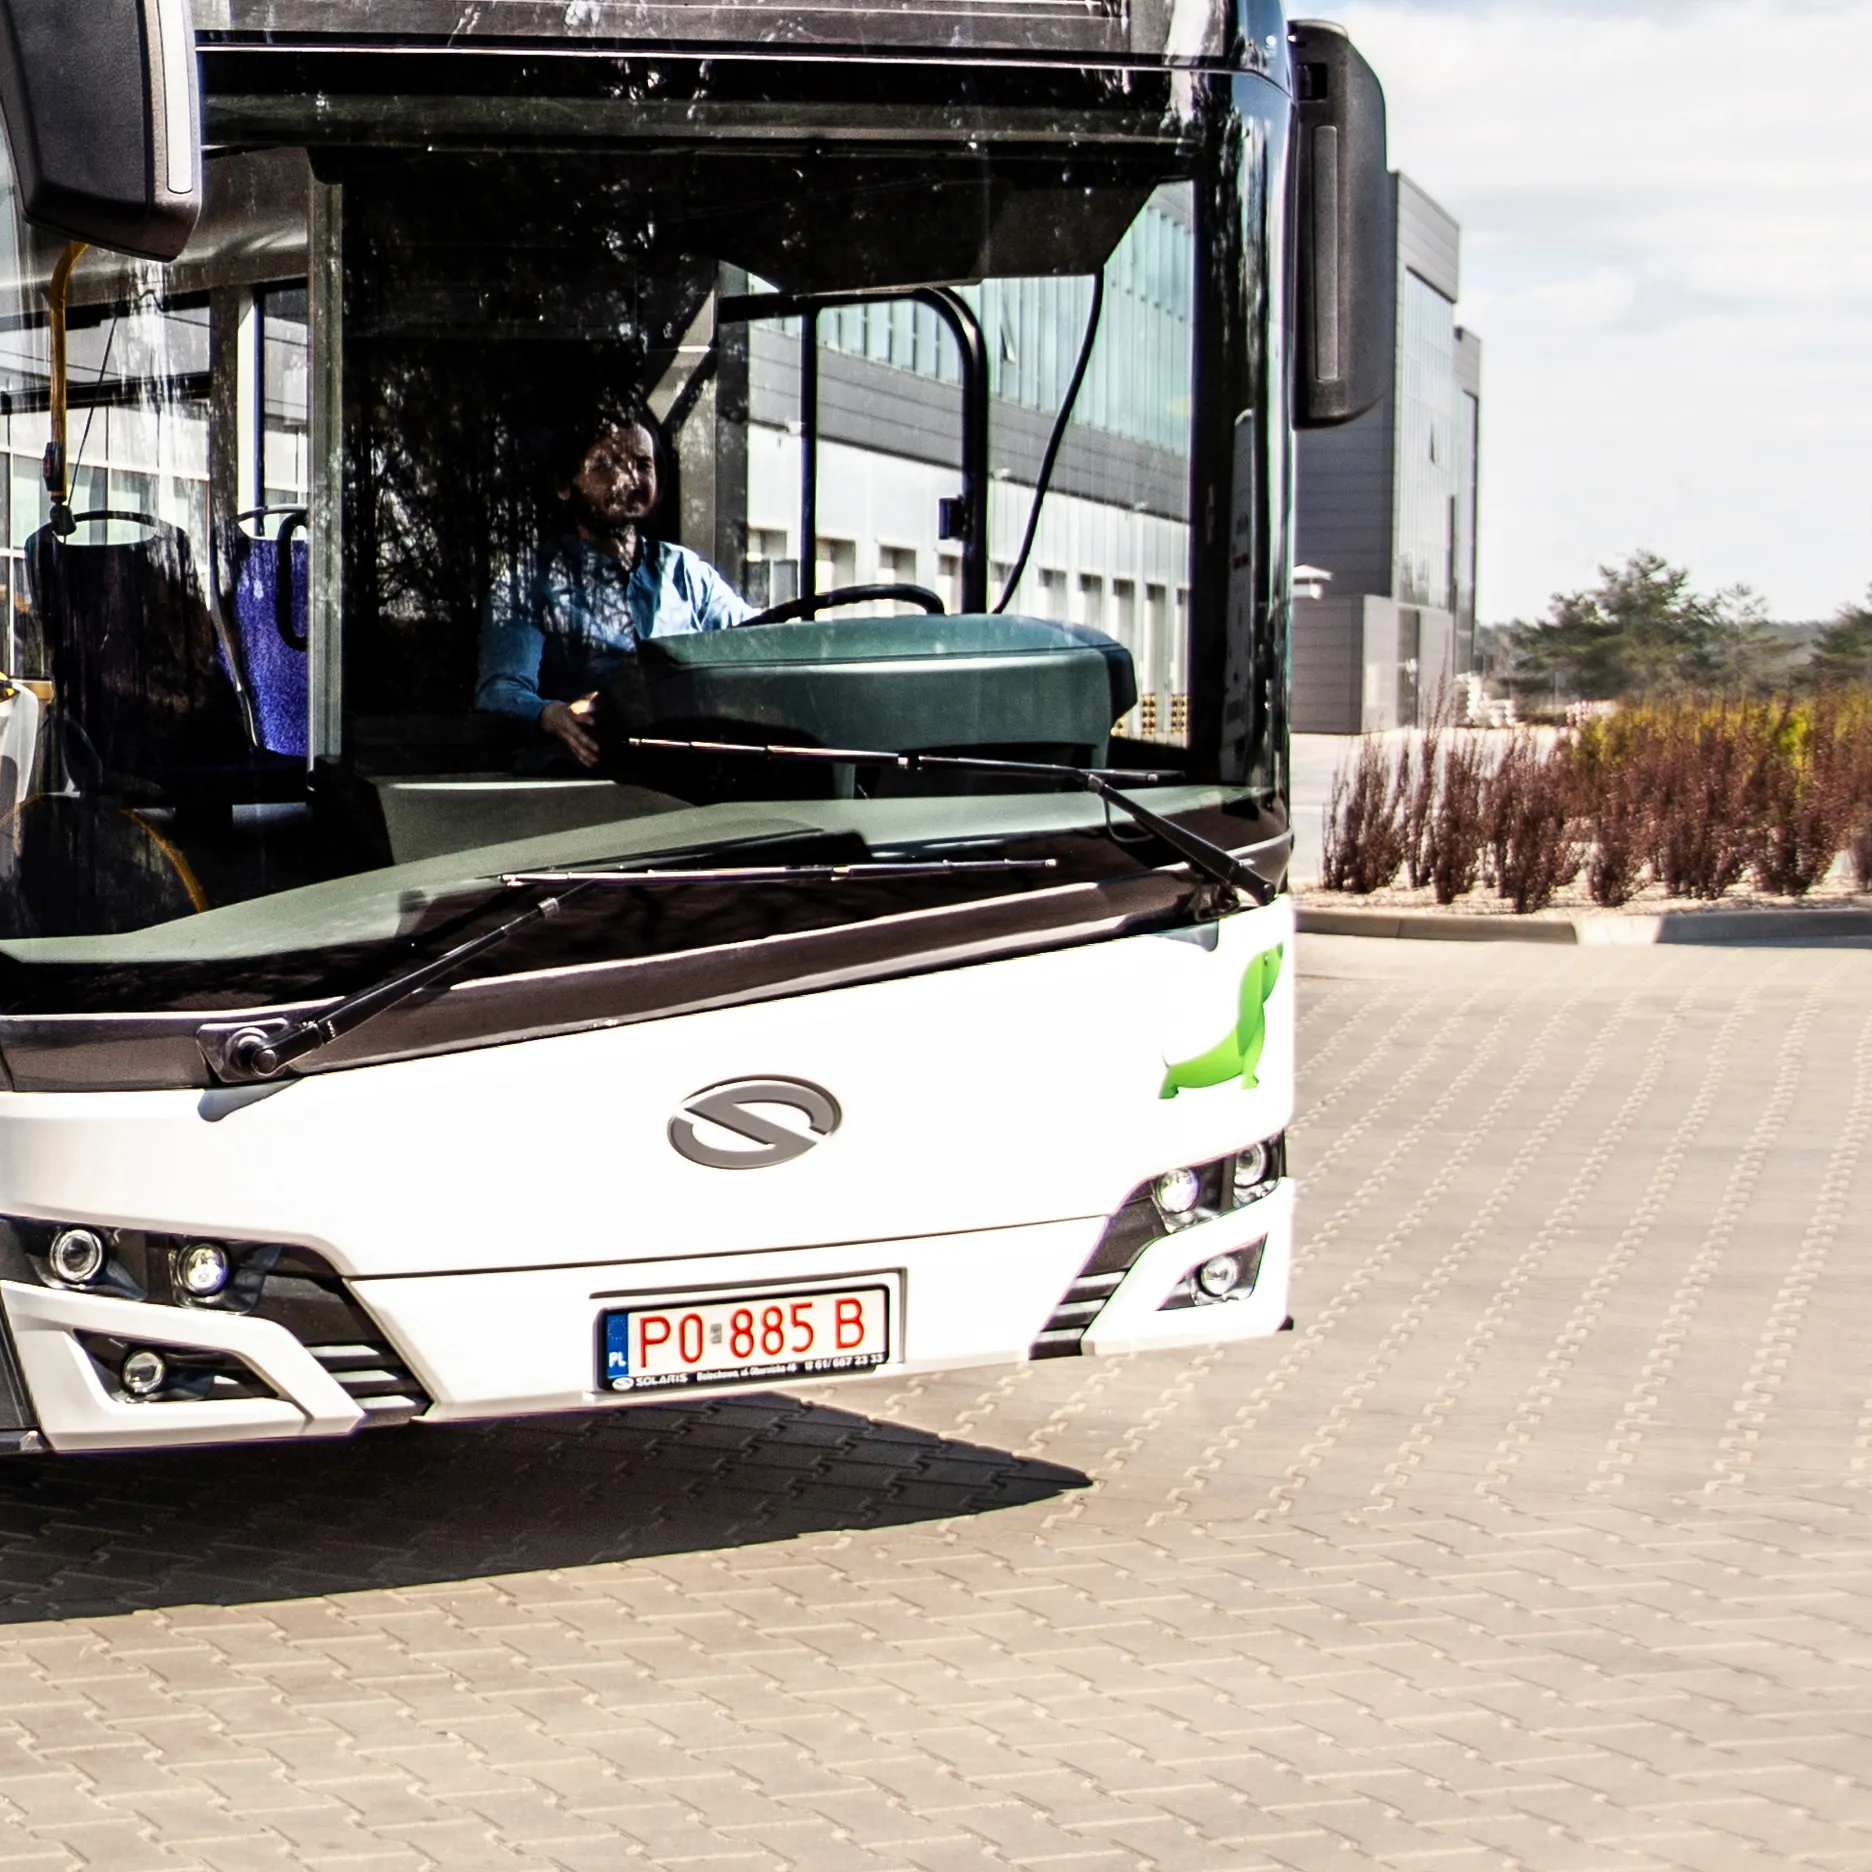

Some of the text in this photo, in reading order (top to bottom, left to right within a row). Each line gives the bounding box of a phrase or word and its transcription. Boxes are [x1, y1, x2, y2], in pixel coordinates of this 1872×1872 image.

[730, 1302, 814, 1359] 885
[835, 1297, 865, 1350] B
[609, 1351, 626, 1368] PL
[636, 1372, 688, 1386] SOLARIS
